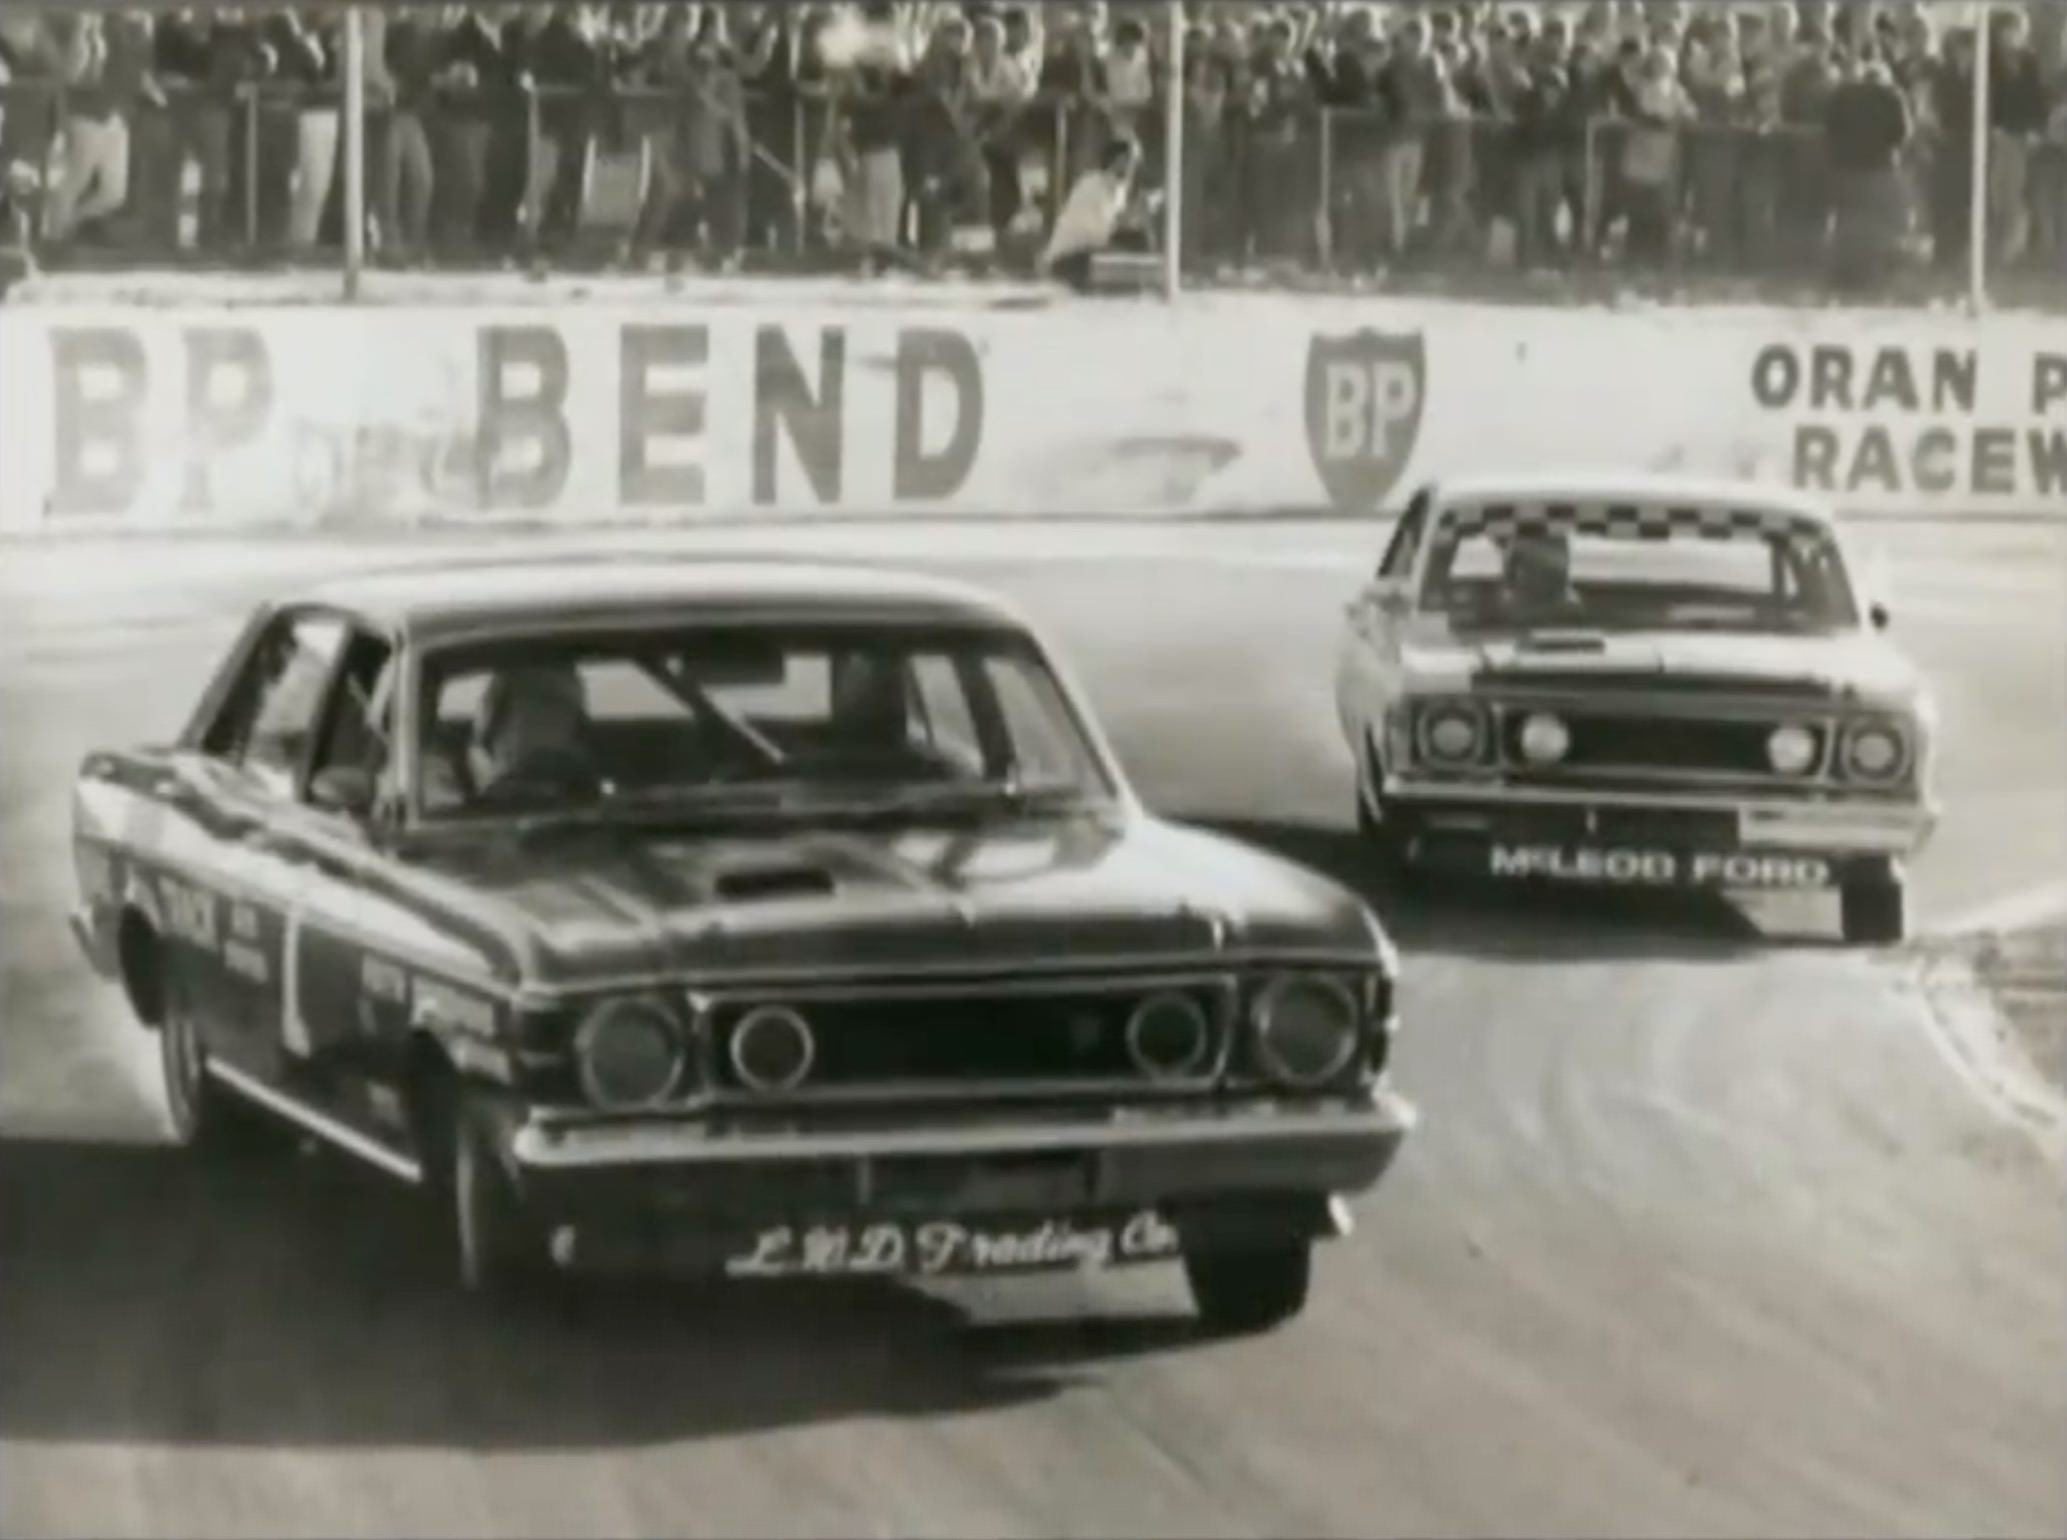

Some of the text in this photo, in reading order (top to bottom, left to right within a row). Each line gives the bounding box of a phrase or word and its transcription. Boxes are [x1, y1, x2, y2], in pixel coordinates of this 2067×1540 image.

[46, 325, 274, 516] BP
[475, 322, 985, 508] BEND
[1324, 360, 1416, 461] BP
[1752, 343, 1978, 411] ORAN
[1692, 848, 1830, 885] FORD
